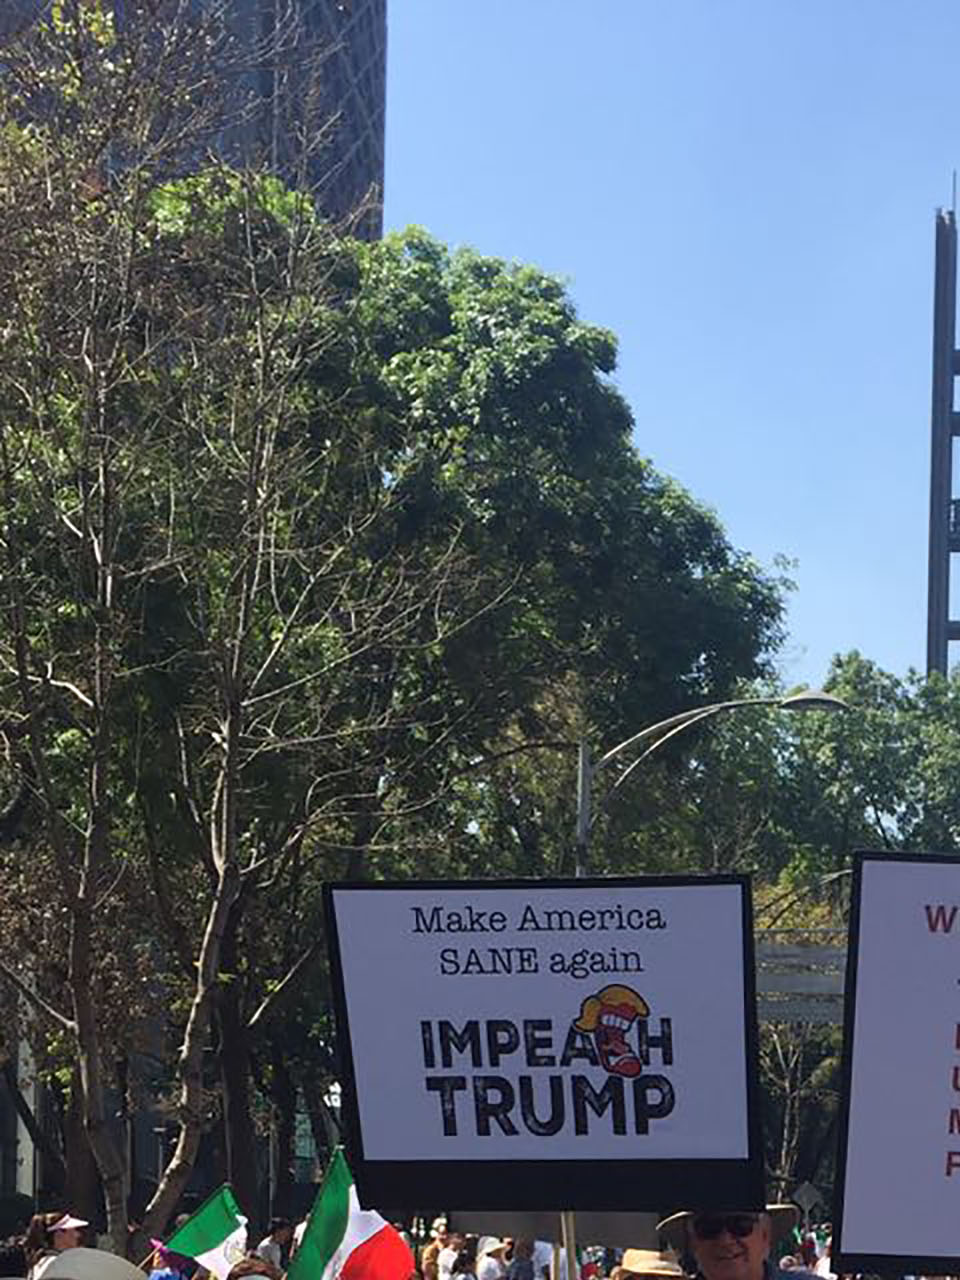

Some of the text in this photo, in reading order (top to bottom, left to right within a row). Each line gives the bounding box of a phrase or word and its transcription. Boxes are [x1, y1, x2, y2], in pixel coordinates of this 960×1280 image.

[411, 904, 666, 933] Make America
[440, 947, 644, 979] SANE again
[425, 1074, 676, 1137] TRUMP
